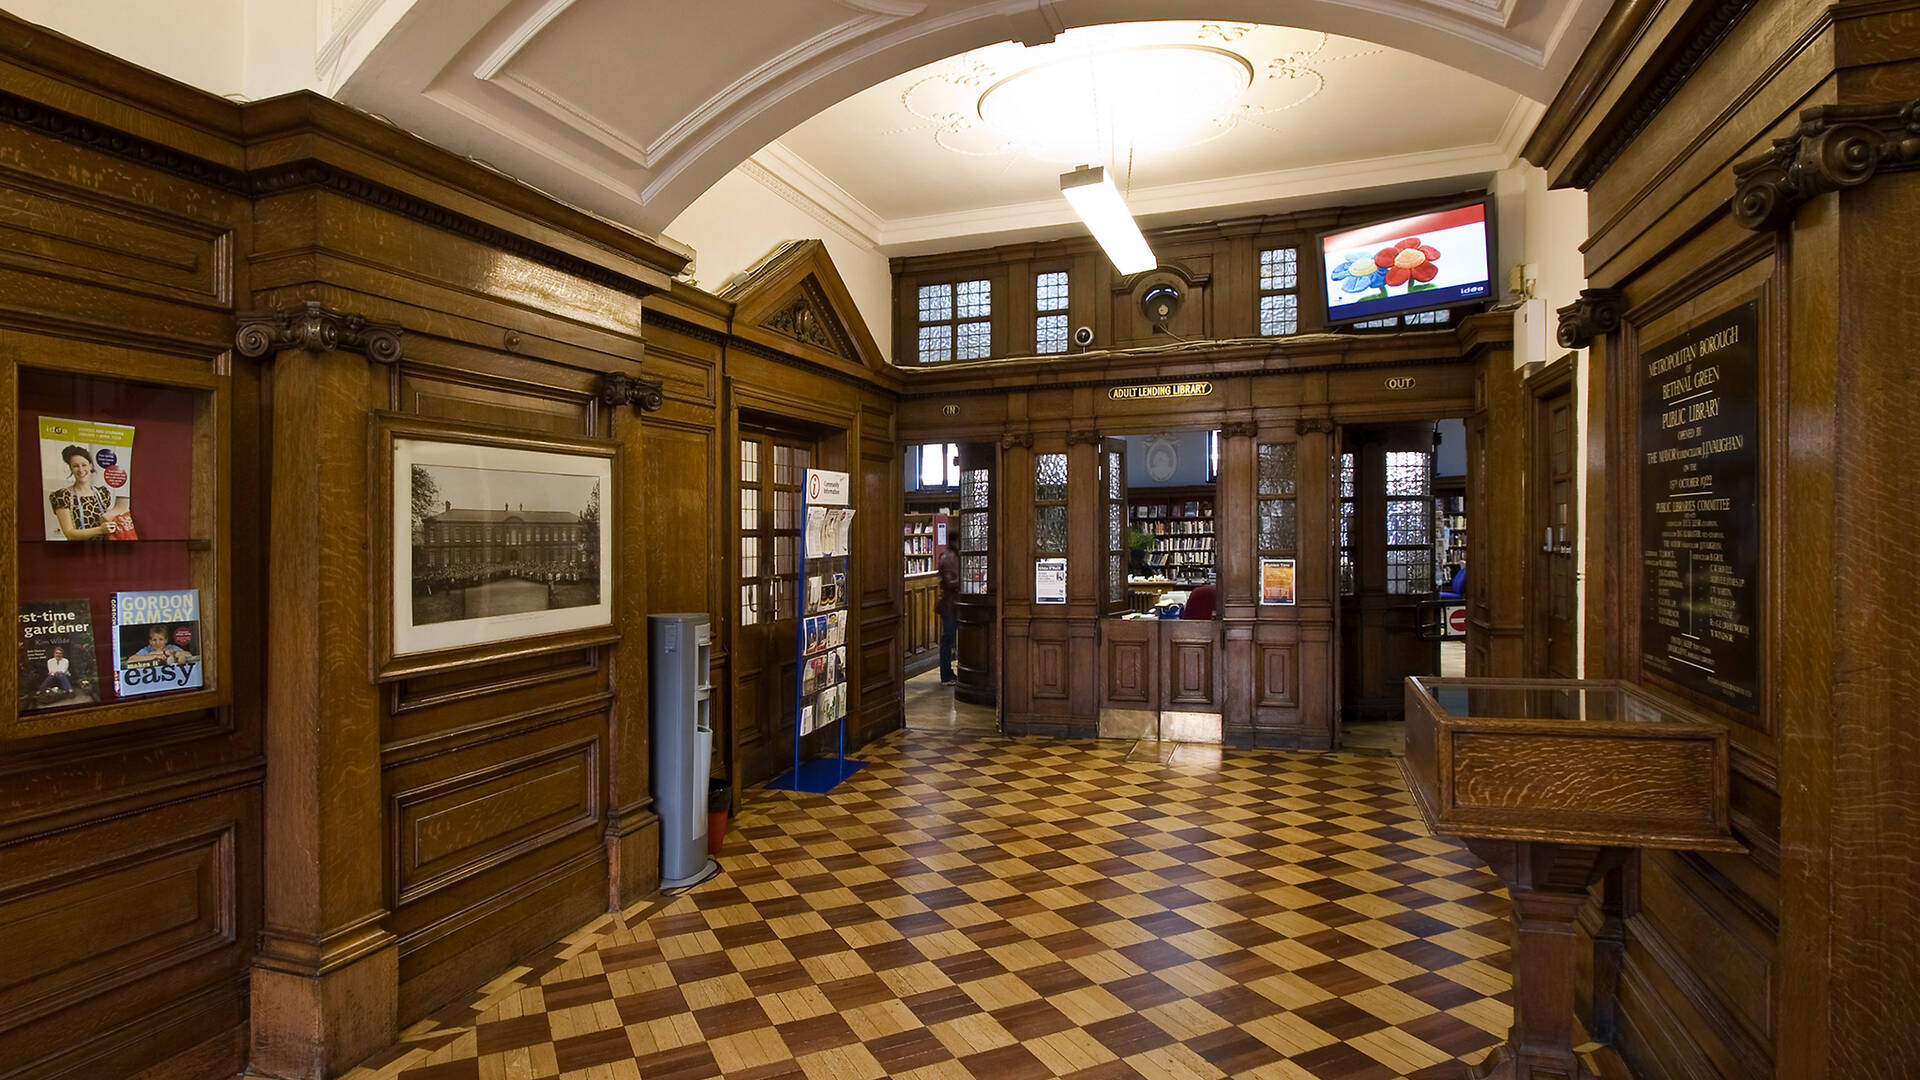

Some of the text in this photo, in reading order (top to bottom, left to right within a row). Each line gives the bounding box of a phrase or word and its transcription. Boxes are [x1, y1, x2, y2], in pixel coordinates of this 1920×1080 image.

[1649, 325, 1739, 378] METROPOLITAN BOROUGH
[1113, 383, 1207, 398] ADULT LENDING LIBRARY
[1389, 378, 1411, 389] OUT
[1662, 365, 1720, 400] BETHNAL GREEN
[946, 405, 956, 415] IN
[1662, 398, 1720, 430] PUBLIC LIBRARY
[1697, 498, 1731, 511] COMMITTEE
[121, 594, 193, 611] GORDON
[18, 610, 76, 623] rst-time
[122, 608, 193, 625] RAMSAY
[24, 622, 89, 638] gardener
[127, 661, 151, 669] makes
[124, 662, 196, 687] easy
